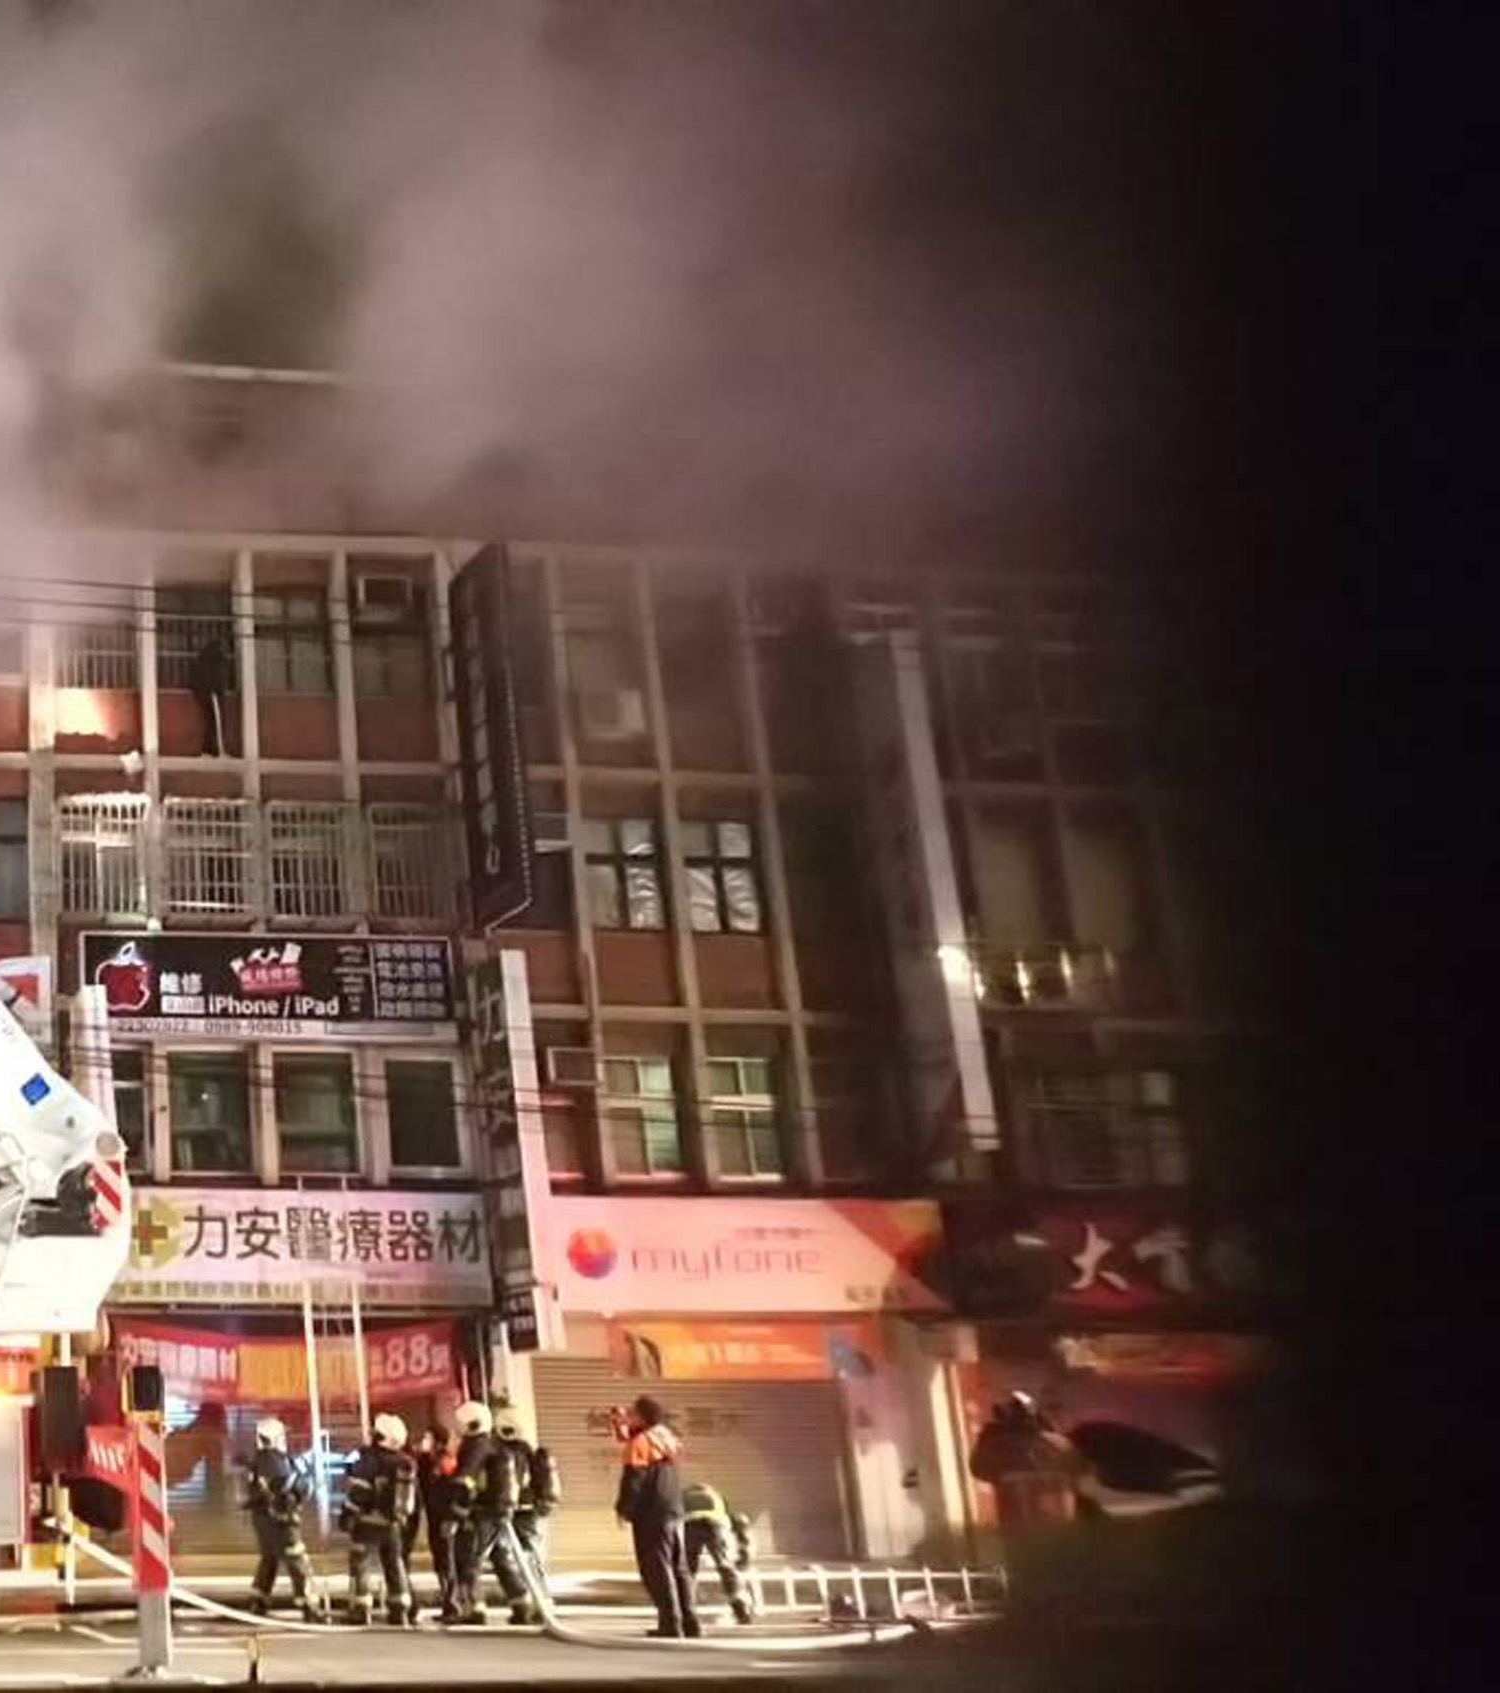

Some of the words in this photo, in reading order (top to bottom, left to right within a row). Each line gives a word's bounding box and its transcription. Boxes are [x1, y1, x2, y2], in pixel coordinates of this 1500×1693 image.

[159, 971, 203, 995] 維修
[208, 995, 279, 1016] iPhone
[294, 995, 340, 1016] iPad
[183, 1204, 482, 1264] 力安醫療器材
[629, 1243, 823, 1282] myfone
